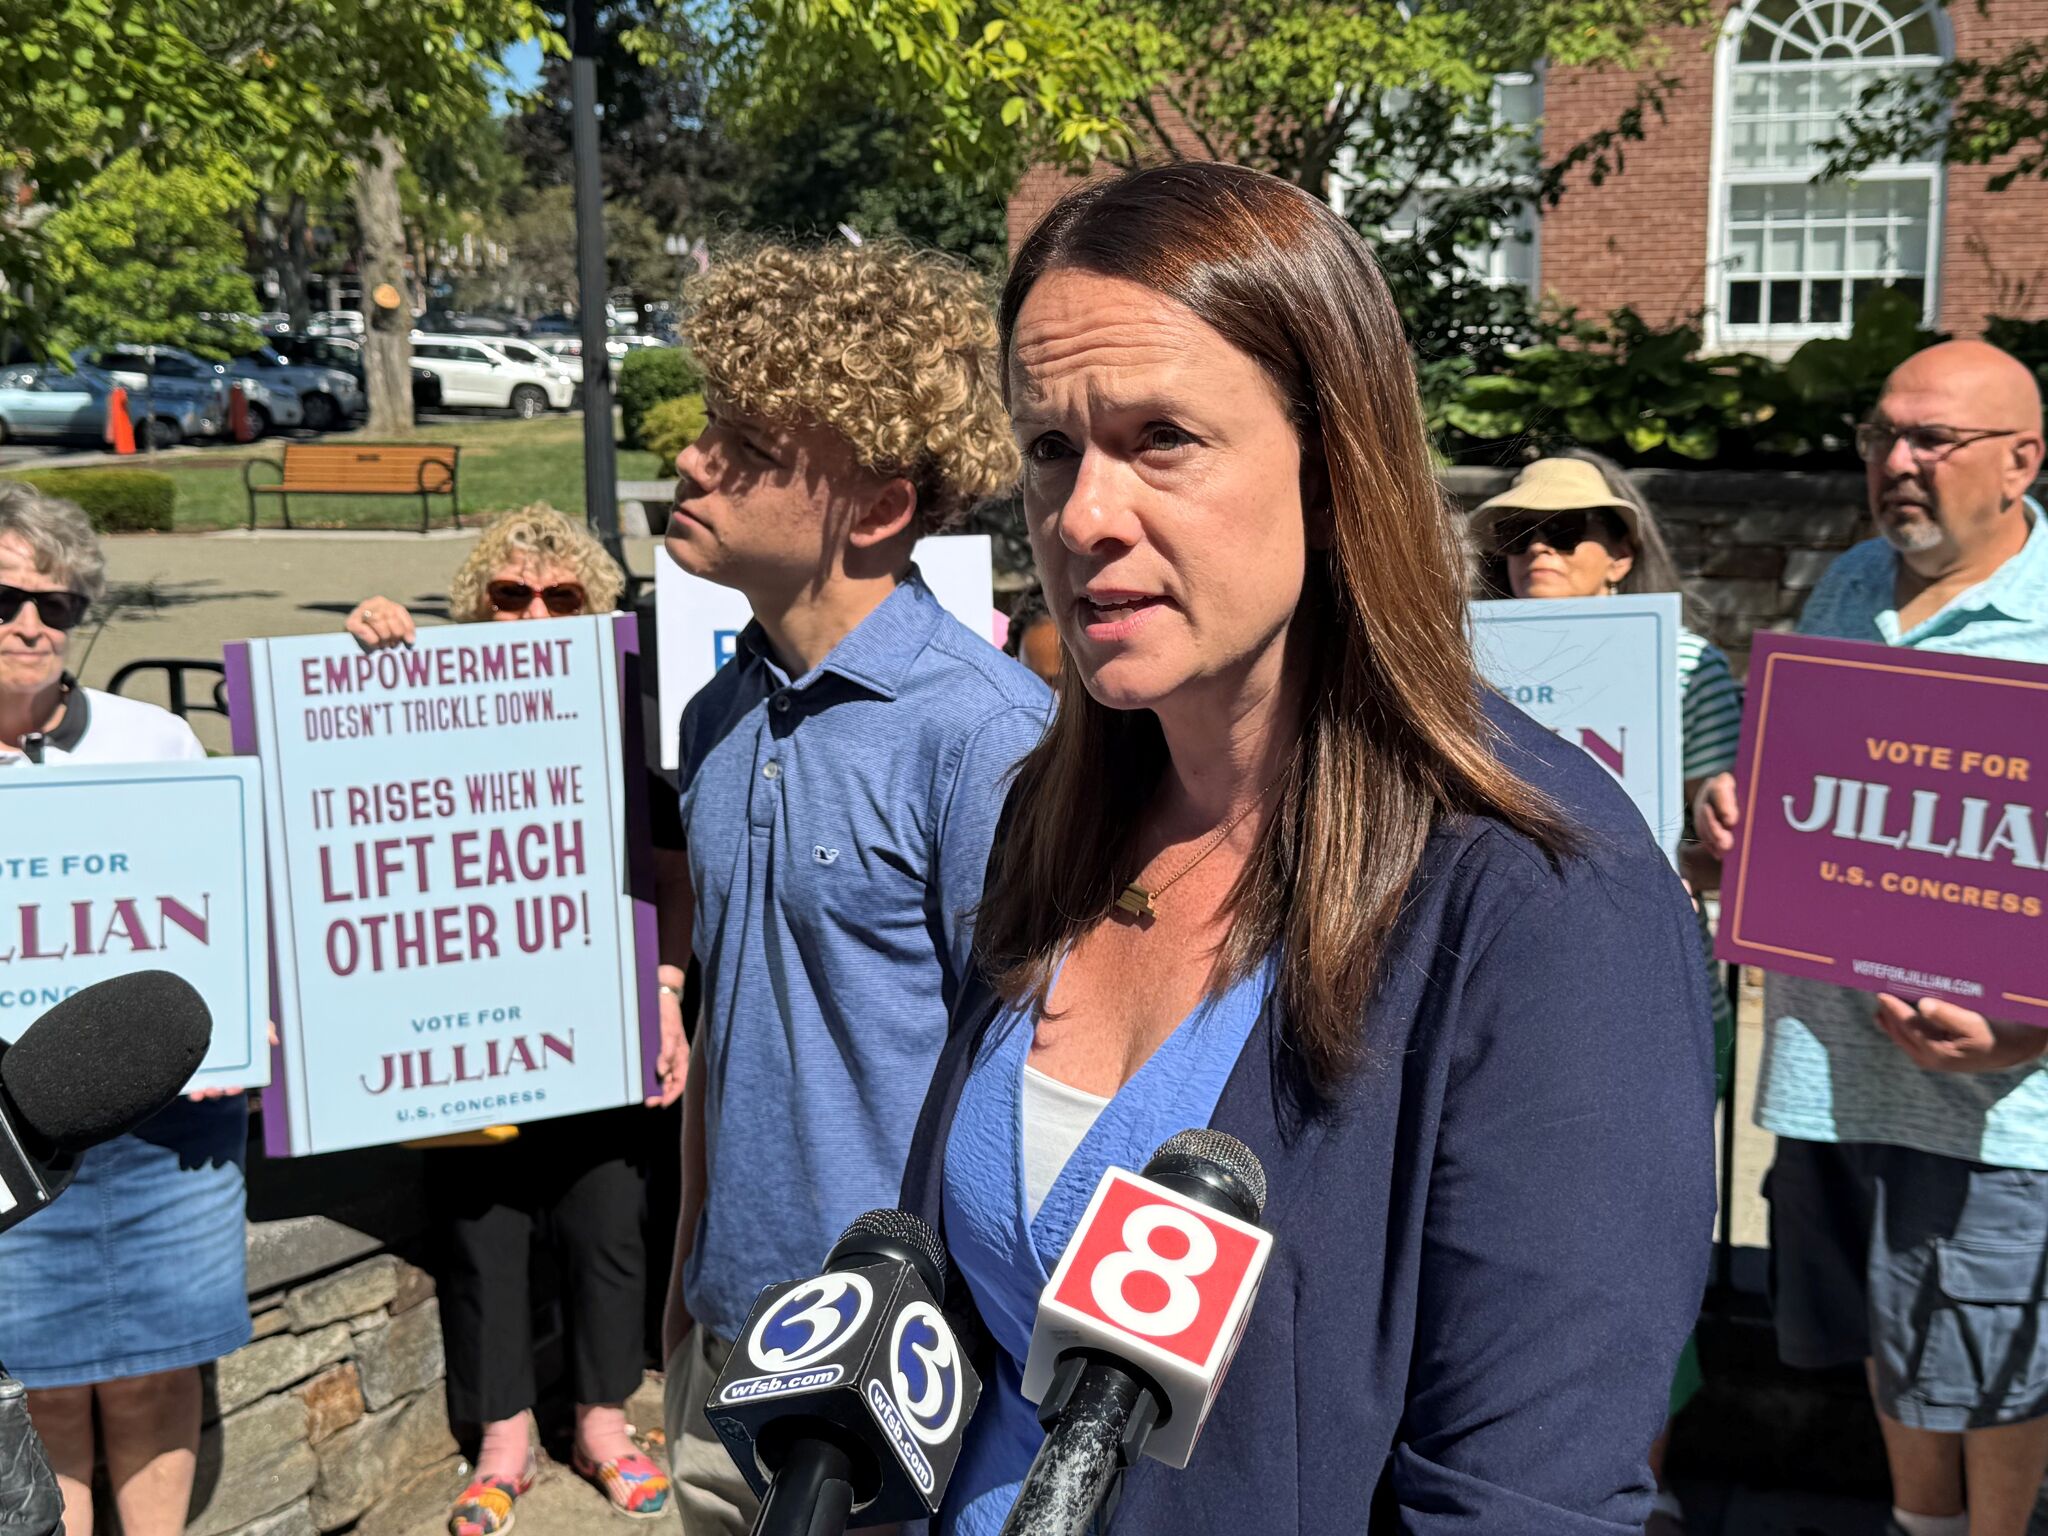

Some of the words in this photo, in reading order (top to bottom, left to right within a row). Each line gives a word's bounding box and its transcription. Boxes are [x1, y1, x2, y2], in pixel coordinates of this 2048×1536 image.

[301, 639, 573, 696] EMPOWERMENT
[304, 702, 394, 741] DOESN'T
[402, 694, 488, 734] TRICKLE
[496, 689, 579, 726] DOWN...
[1866, 738, 1954, 771] VOTE
[1960, 750, 2031, 782] FOR
[312, 788, 336, 830] IT
[347, 777, 456, 827] RISES
[466, 769, 538, 815] WHEN
[546, 765, 584, 806] WE
[1782, 774, 2048, 870] JILLIA
[0, 857, 48, 878] TE
[61, 853, 130, 876] FOR
[319, 835, 434, 903] LIFT
[452, 819, 586, 889] EACH
[1820, 861, 1873, 888] U.S.
[1880, 872, 2043, 917] CONGRESS
[0, 892, 210, 964] LIAN
[326, 904, 500, 977] OTHER
[515, 890, 592, 954] UP!
[411, 1012, 470, 1033] VOTE
[478, 1005, 521, 1025] FOR
[359, 1028, 576, 1096] JILLIAN
[396, 1108, 436, 1123] U.S.
[442, 1089, 547, 1116] CONGRESS
[1090, 1204, 1217, 1337] 8
[756, 1273, 860, 1370] 3
[731, 1370, 834, 1395] wfsb.com
[895, 1308, 957, 1430] 3
[872, 1389, 929, 1487] wfsb.com
